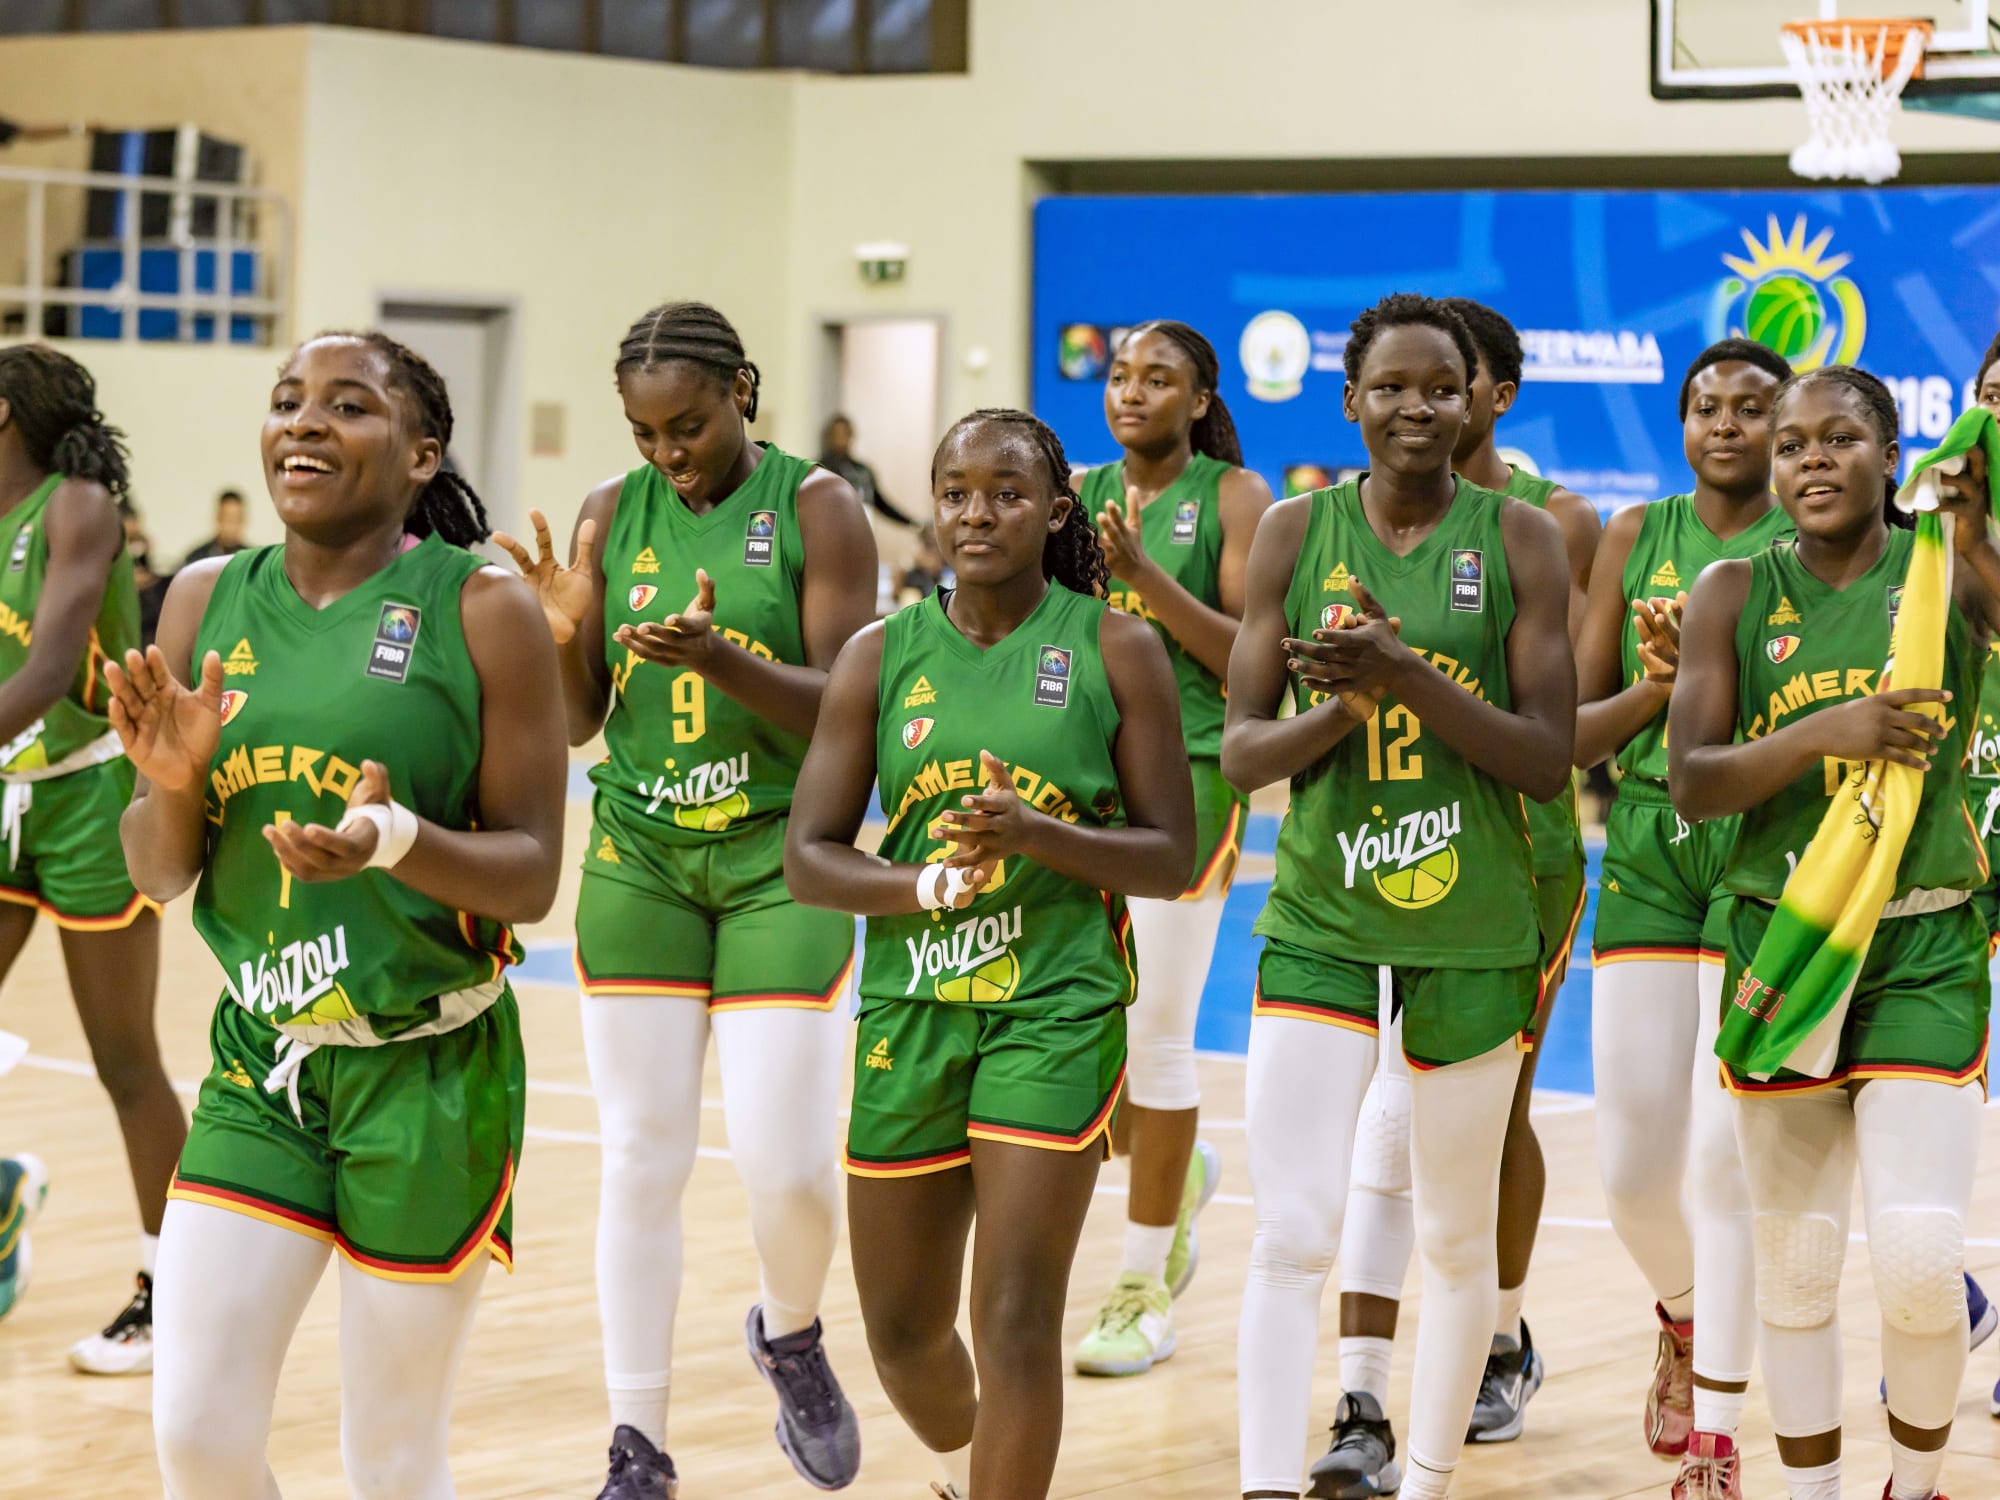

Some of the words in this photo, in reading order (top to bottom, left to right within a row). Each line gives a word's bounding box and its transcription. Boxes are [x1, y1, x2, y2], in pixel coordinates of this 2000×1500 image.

[749, 541, 769, 552] FIBA
[632, 562, 661, 574] PEAK
[1323, 578, 1350, 592] PEA
[1455, 584, 1478, 596] FIBA
[1650, 575, 1682, 587] PEAK
[1767, 613, 1802, 626] PEAK
[376, 645, 405, 663] FIBA
[1040, 679, 1063, 692] FIBA
[671, 671, 706, 743] 9
[904, 691, 938, 709] PEAK
[1367, 703, 1423, 781] 12
[205, 743, 362, 828] CAMERO
[637, 751, 749, 814] YouZou
[1336, 800, 1462, 889] YouZou
[905, 905, 1023, 996] YouZou
[239, 924, 350, 1016] YouZou
[865, 1054, 895, 1071] PEAK
